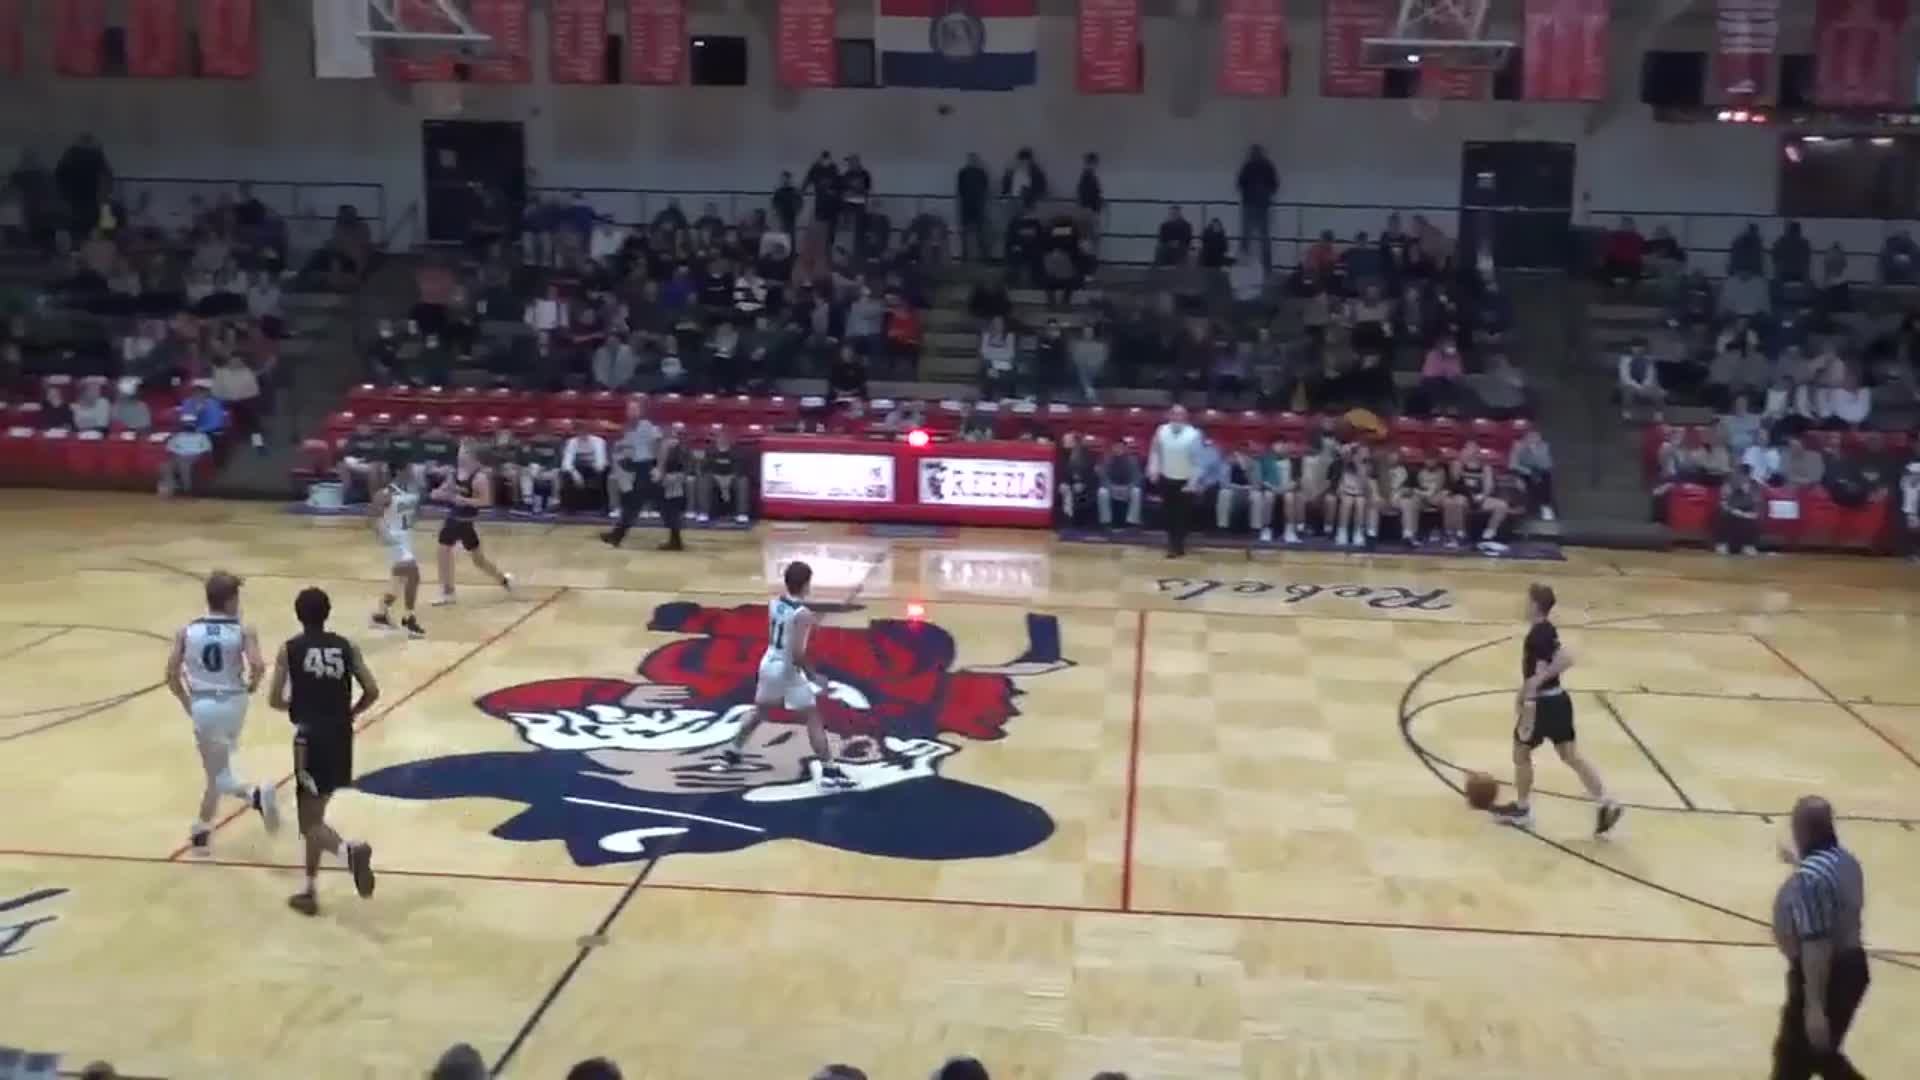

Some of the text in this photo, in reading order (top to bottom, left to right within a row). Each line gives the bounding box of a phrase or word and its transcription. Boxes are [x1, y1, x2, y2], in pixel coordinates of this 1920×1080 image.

[1156, 577, 1453, 611] Rebels
[202, 641, 223, 673] 0
[303, 647, 346, 680] 45
